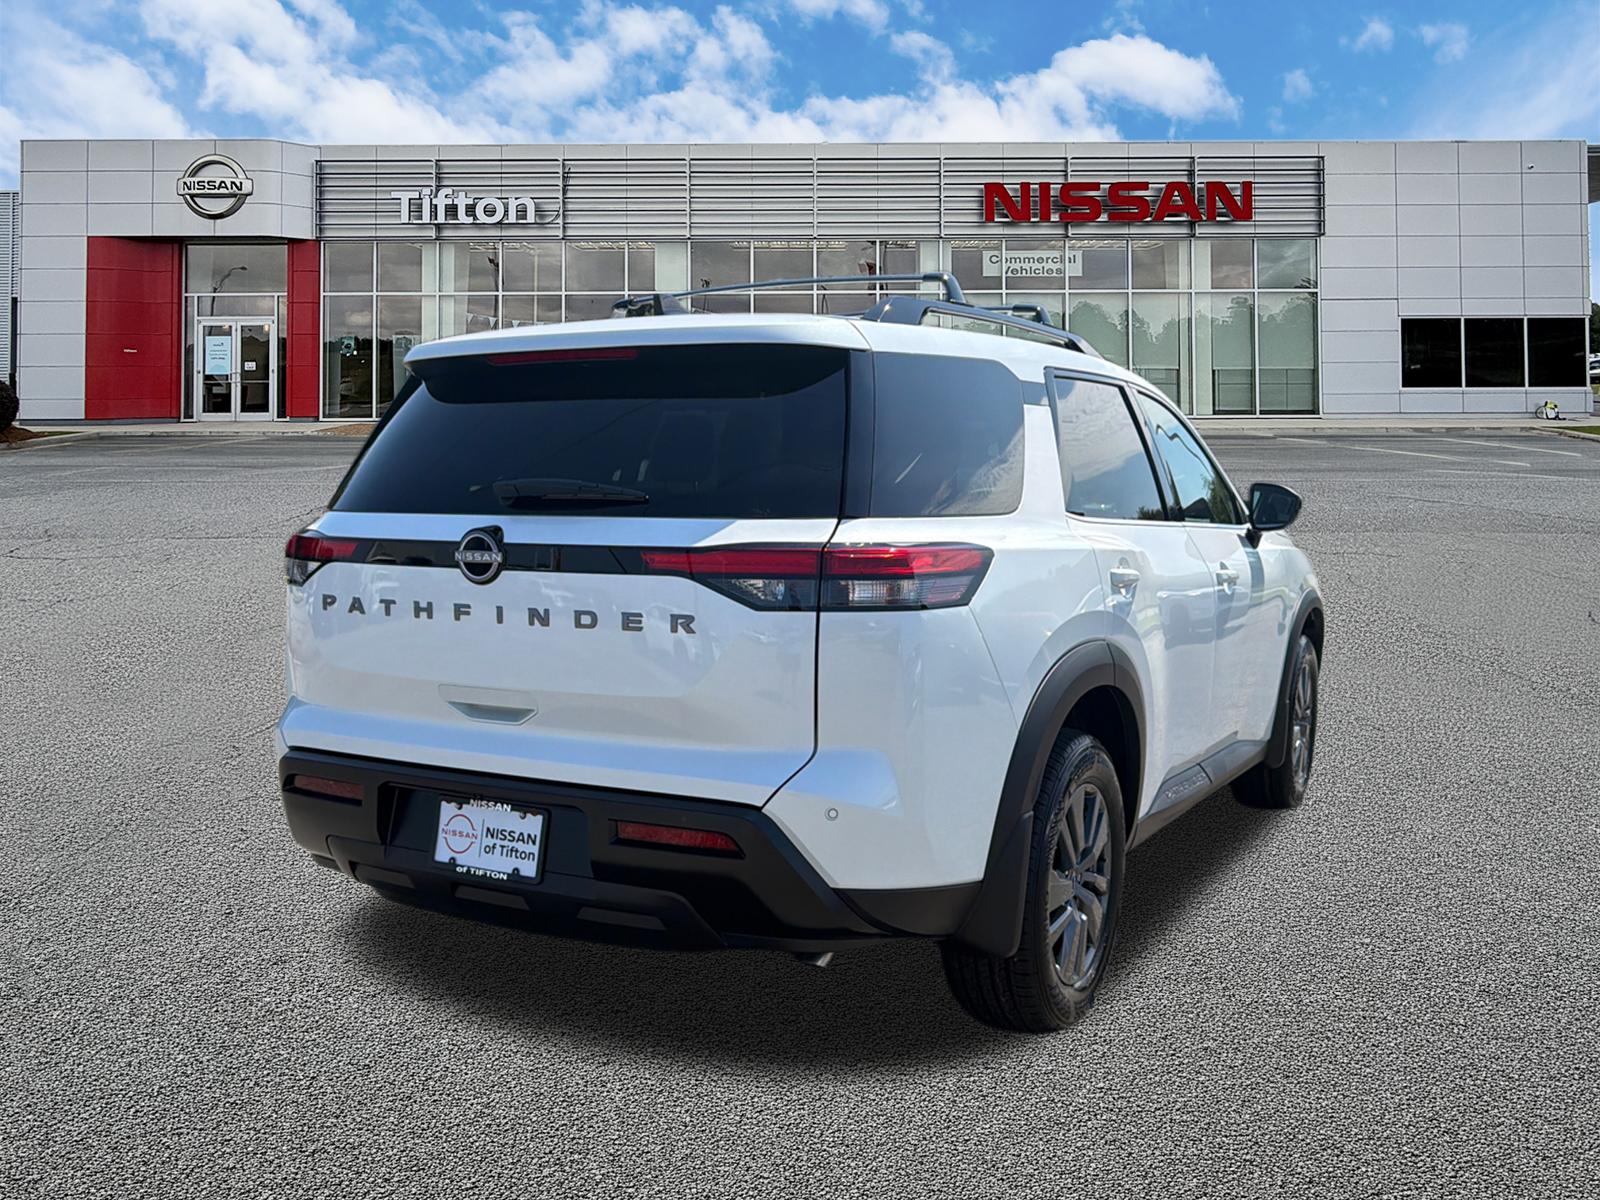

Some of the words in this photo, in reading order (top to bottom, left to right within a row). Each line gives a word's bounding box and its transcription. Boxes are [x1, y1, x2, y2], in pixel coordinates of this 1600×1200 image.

[182, 180, 243, 191] NISSAN
[391, 188, 536, 224] Tifton
[983, 180, 1253, 223] NISSAN
[454, 551, 502, 563] NISSAN
[322, 593, 696, 634] PATHFINDER
[469, 799, 511, 812] NISSAN
[441, 827, 478, 840] NISSAN
[485, 826, 537, 846] NISSAN
[484, 843, 496, 856] of
[499, 845, 536, 862] Tifton
[456, 865, 468, 873] of
[469, 867, 508, 880] TIFTON
